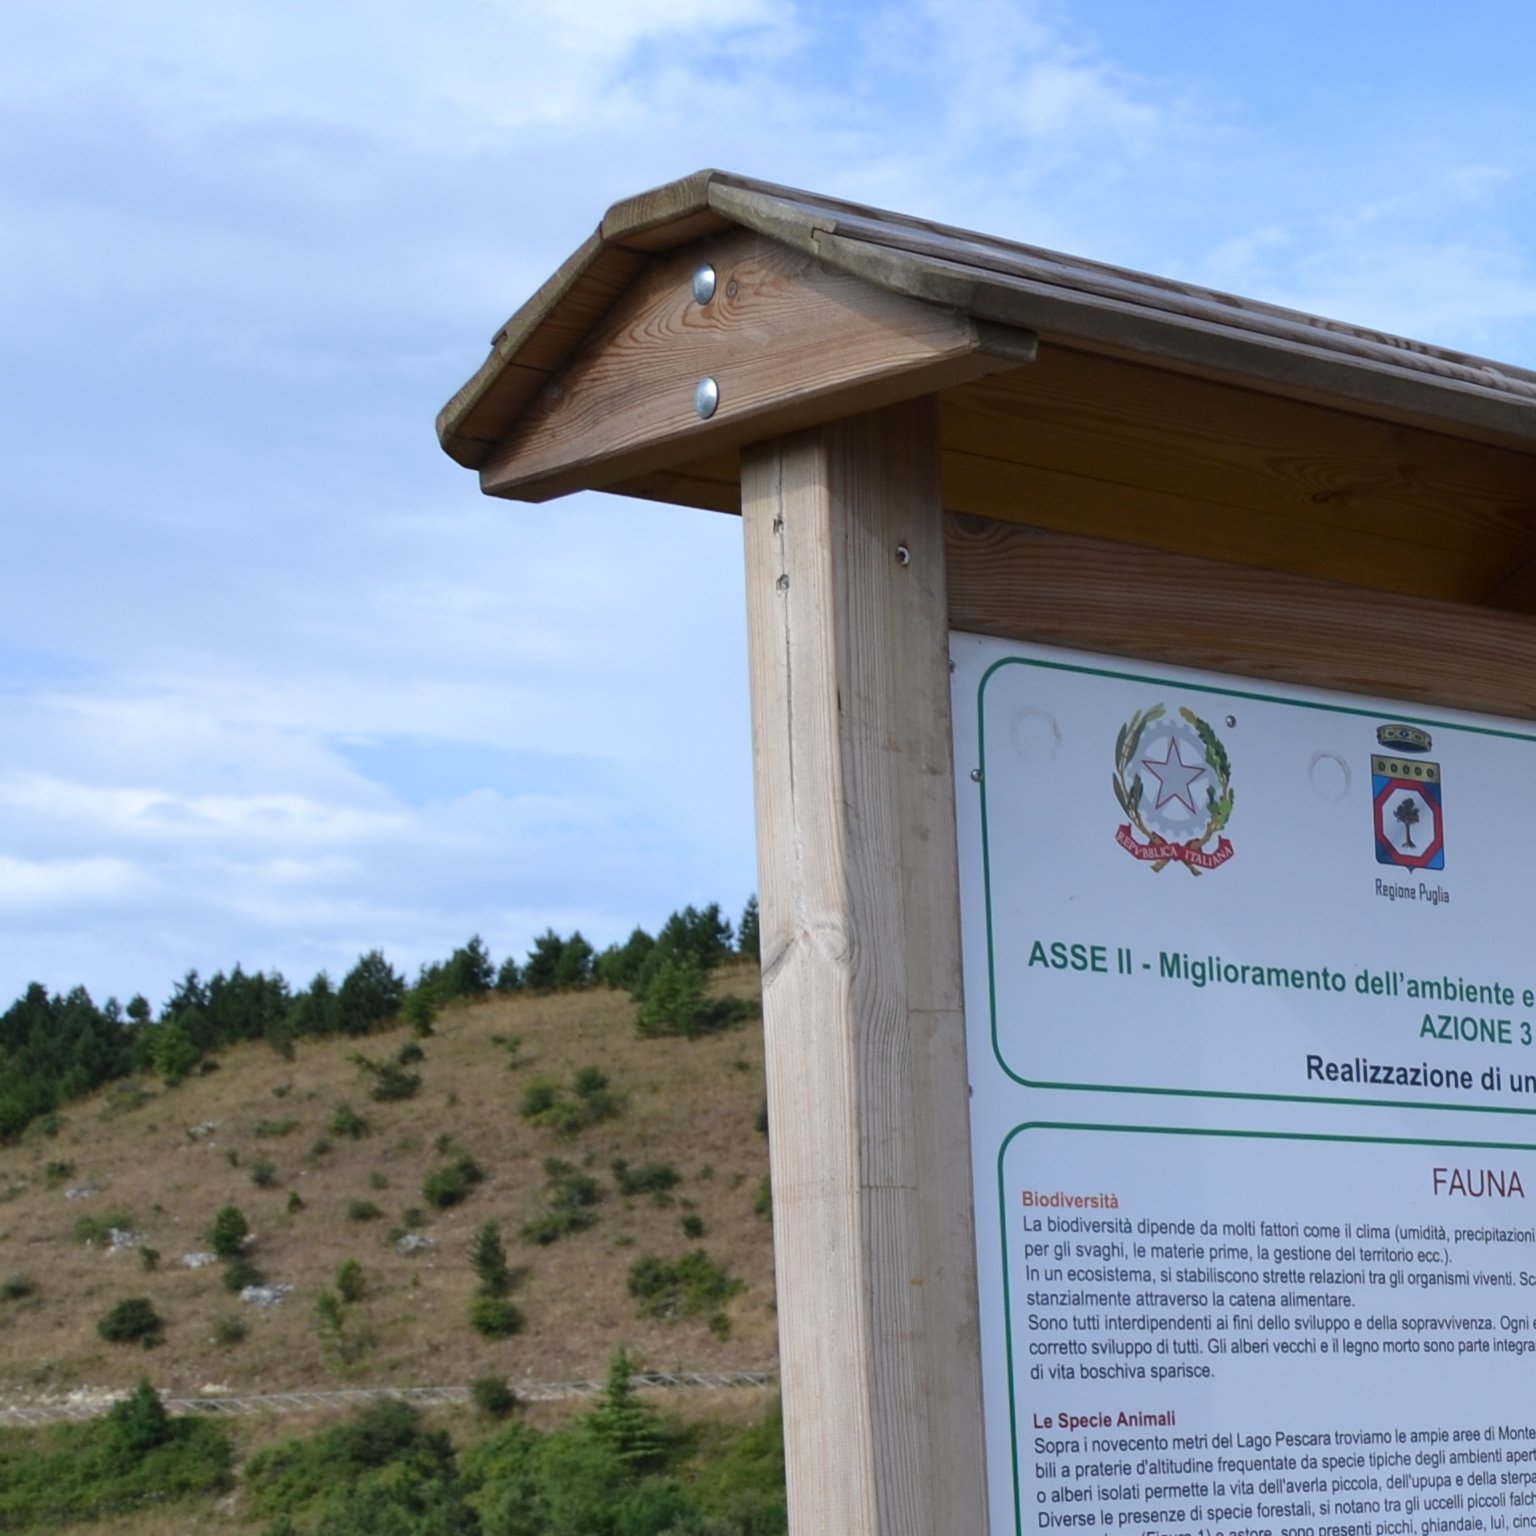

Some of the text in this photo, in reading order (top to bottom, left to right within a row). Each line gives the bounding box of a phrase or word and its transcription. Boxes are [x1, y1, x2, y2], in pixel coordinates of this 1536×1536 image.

[1184, 845, 1233, 869] ITALIANA
[1375, 877, 1450, 906] Regione Puglia
[1028, 940, 1108, 973] ASSE
[1117, 947, 1132, 975] II
[1159, 951, 1346, 992] Miglioramento
[1522, 989, 1534, 1008] e
[1419, 1013, 1512, 1044] AZIONE
[1520, 1021, 1532, 1046] 3
[1306, 1054, 1473, 1089] Realizzazione
[1480, 1066, 1501, 1091] di
[1509, 1074, 1536, 1093] un
[1433, 1167, 1525, 1198] FAUNA
[1022, 1190, 1118, 1209] Biodiversità
[1024, 1240, 1452, 1266] per gli svaghi, le materie prime, la gestione del territorio ecc.).
[1026, 1289, 1355, 1307] stanzialmente attraverso la catena alimentare.
[1030, 1362, 1214, 1382] di vita boschiva sparisce.
[1033, 1410, 1175, 1432] Le Specie Animali
